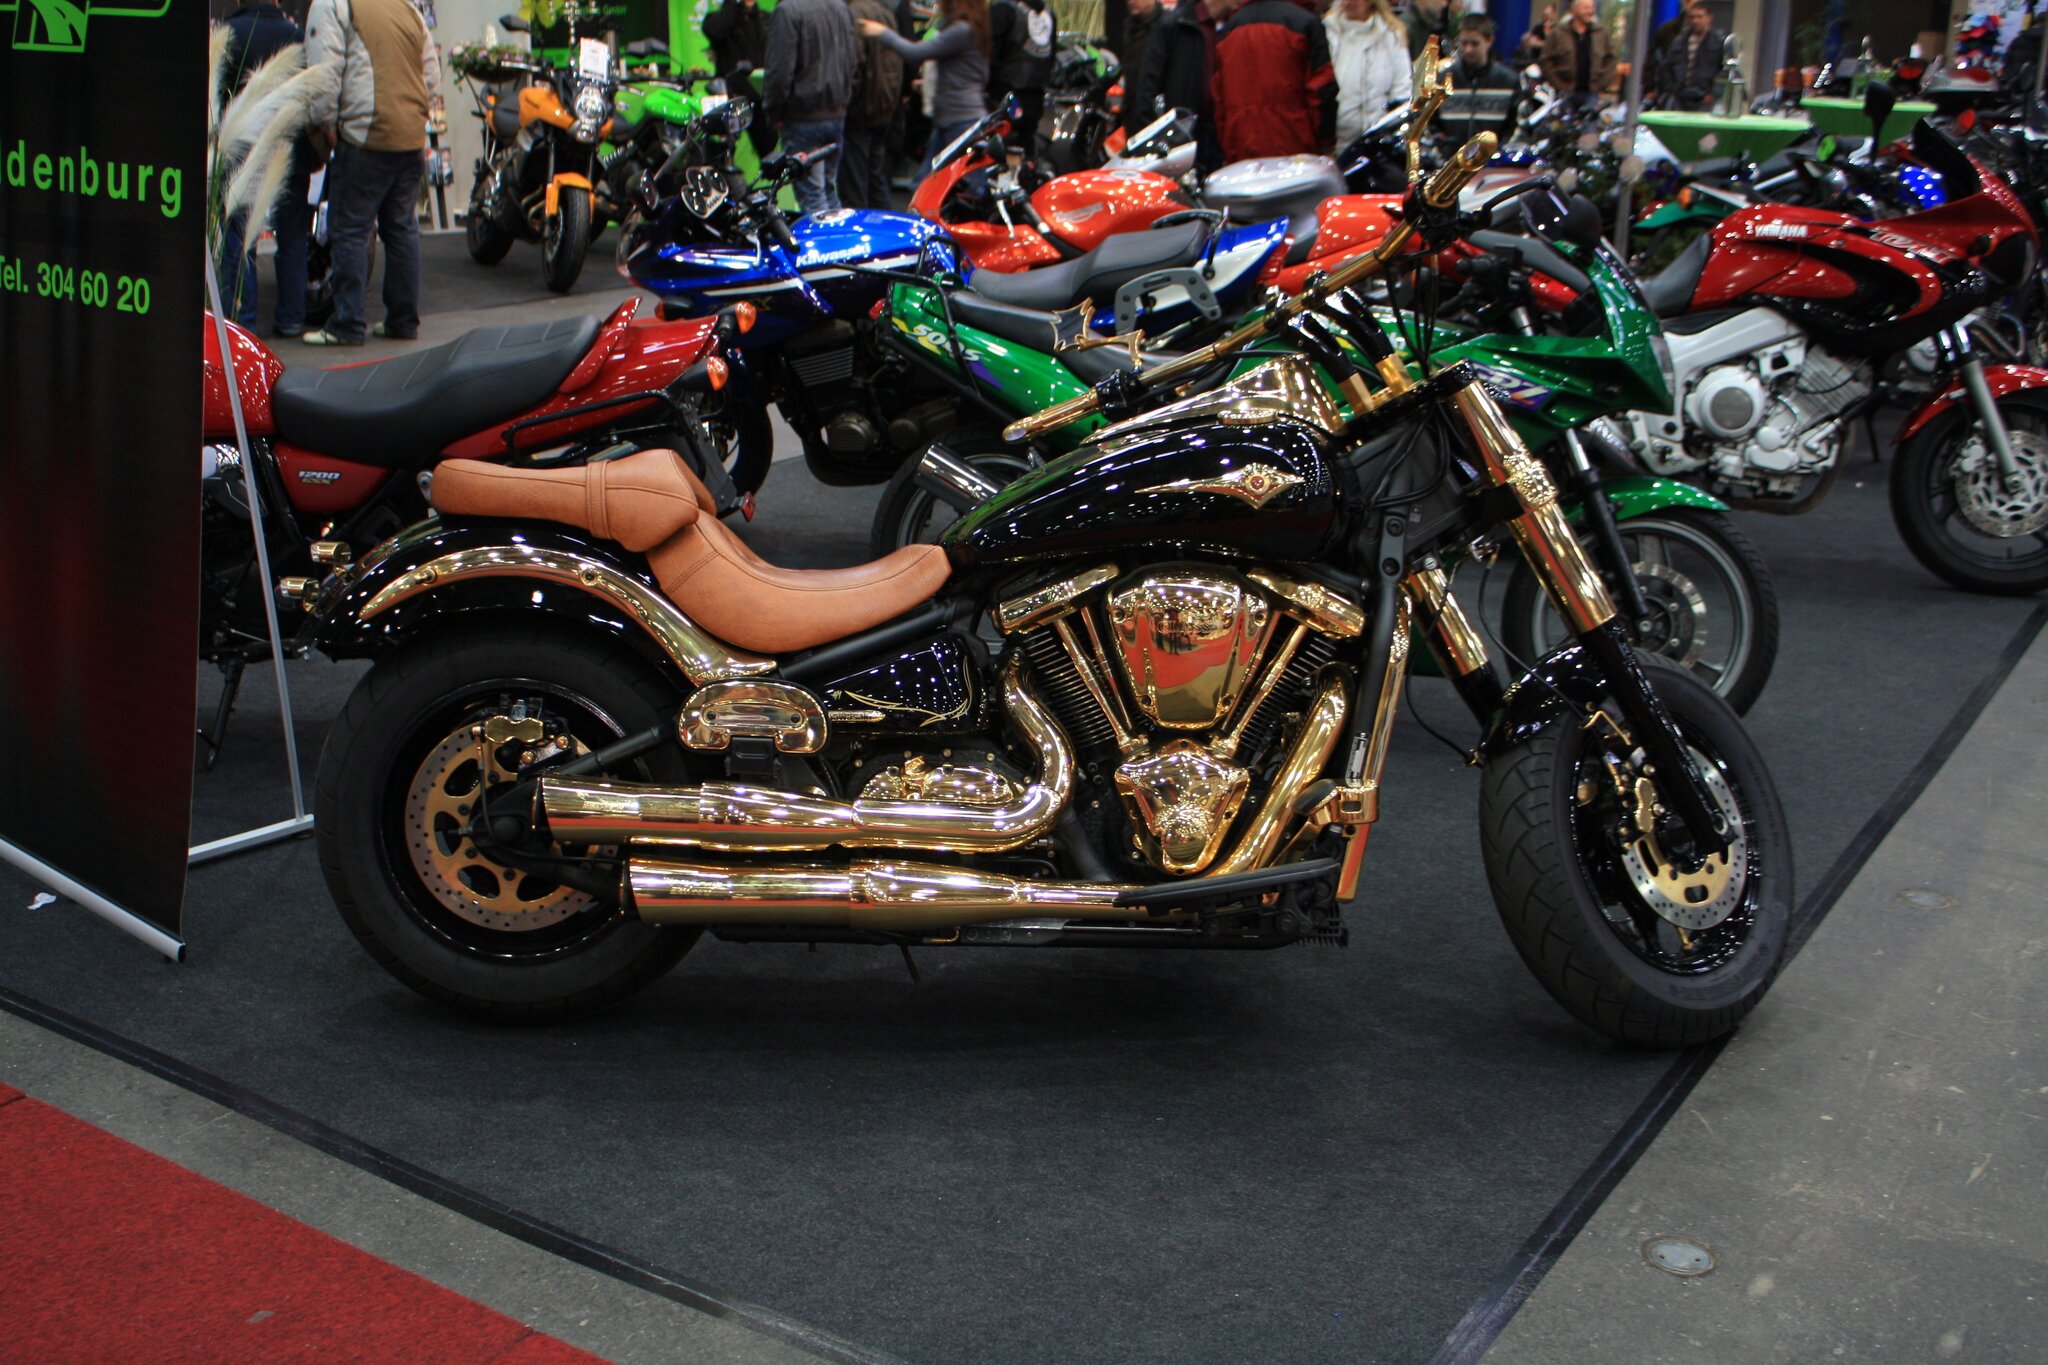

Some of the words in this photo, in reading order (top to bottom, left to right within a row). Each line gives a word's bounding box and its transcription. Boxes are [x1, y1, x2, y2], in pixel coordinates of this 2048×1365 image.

[0, 139, 183, 218] denburg
[1755, 224, 1808, 237] YAMAHA
[796, 242, 871, 268] Kawasaki
[0, 255, 29, 293] Tel.
[37, 262, 75, 301] 304
[80, 270, 109, 308] 60
[117, 276, 150, 315] 20
[298, 470, 341, 480] 1200
